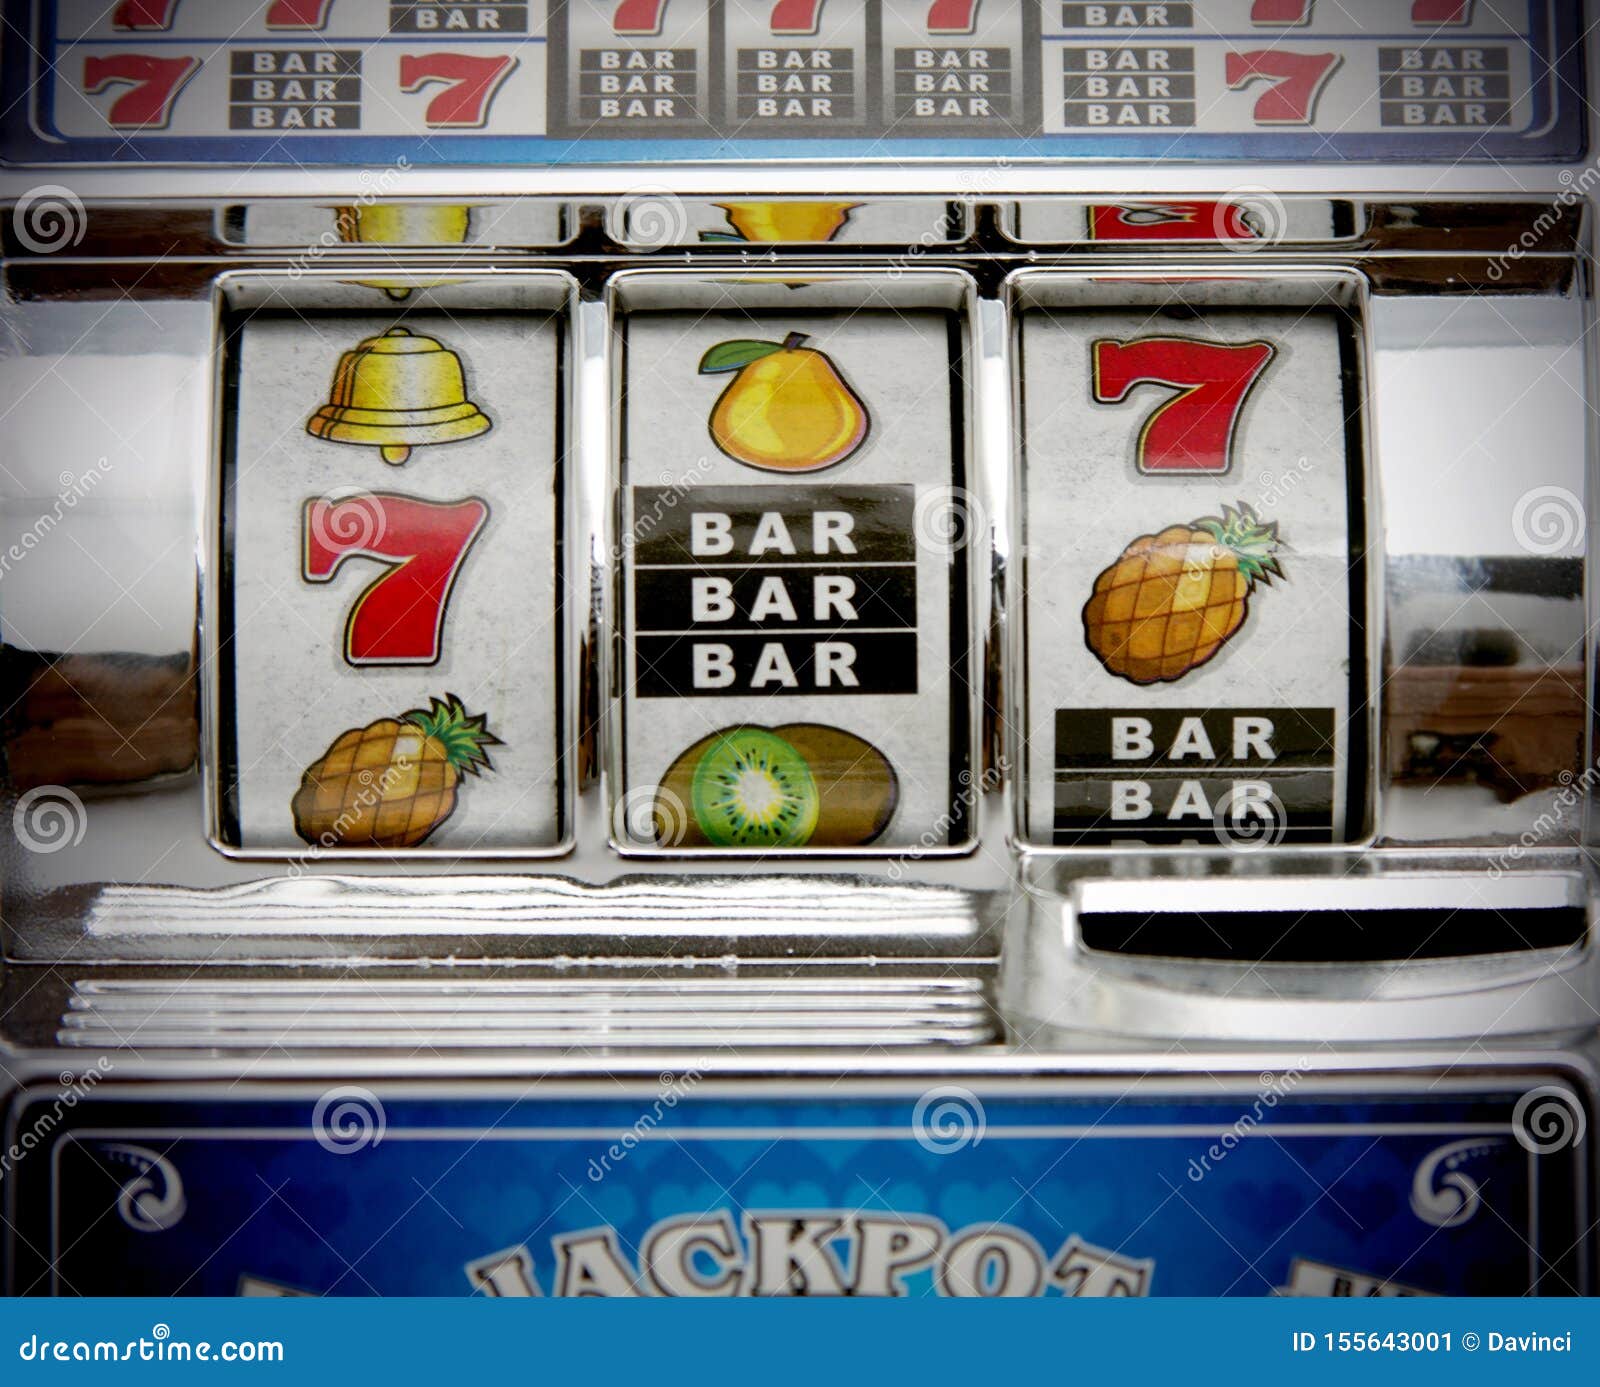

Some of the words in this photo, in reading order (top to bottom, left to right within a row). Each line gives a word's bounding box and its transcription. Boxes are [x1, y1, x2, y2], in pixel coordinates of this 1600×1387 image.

[415, 8, 500, 29] BAR
[1085, 5, 1168, 25] BAR
[253, 52, 338, 73] BAR
[600, 51, 675, 69] BAR
[757, 50, 832, 68] BAR
[914, 49, 989, 67] BAR
[1086, 49, 1171, 70] BAR
[1401, 49, 1485, 69] BAR
[252, 79, 337, 101] BAR
[600, 75, 675, 94] BAR
[757, 75, 832, 94] BAR
[914, 74, 989, 93] BAR
[1087, 76, 1171, 97] BAR
[1402, 76, 1486, 97] BAR
[251, 107, 337, 128] BAR
[600, 99, 675, 117] BAR
[757, 99, 832, 117] BAR
[914, 98, 989, 116] BAR
[1088, 105, 1171, 125] BAR
[1403, 103, 1487, 125] BAR
[691, 510, 858, 556] BAR
[691, 575, 859, 622] BAR
[692, 642, 860, 688] BAR
[1111, 717, 1277, 760] BAR
[1110, 780, 1275, 820] BAR
